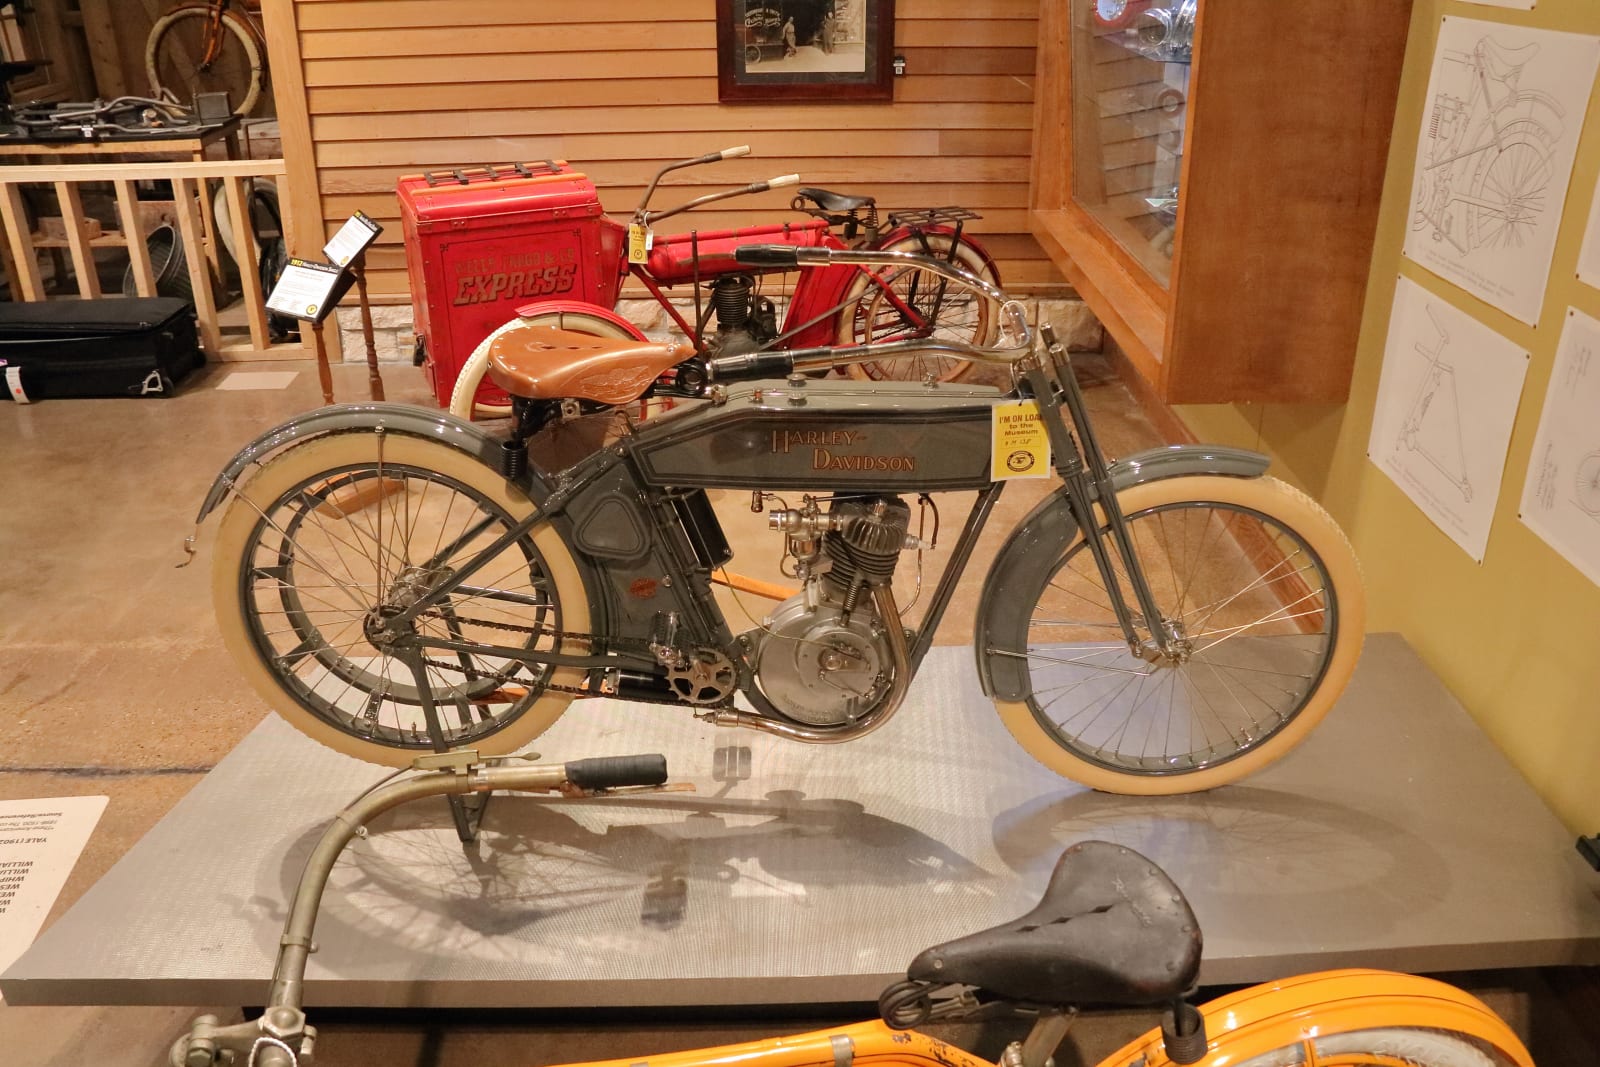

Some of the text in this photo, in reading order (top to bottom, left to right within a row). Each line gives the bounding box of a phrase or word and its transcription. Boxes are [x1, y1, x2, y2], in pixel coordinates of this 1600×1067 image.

[453, 264, 577, 307] EXPRESS
[999, 415, 1011, 424] I'M
[1012, 414, 1023, 423] ON
